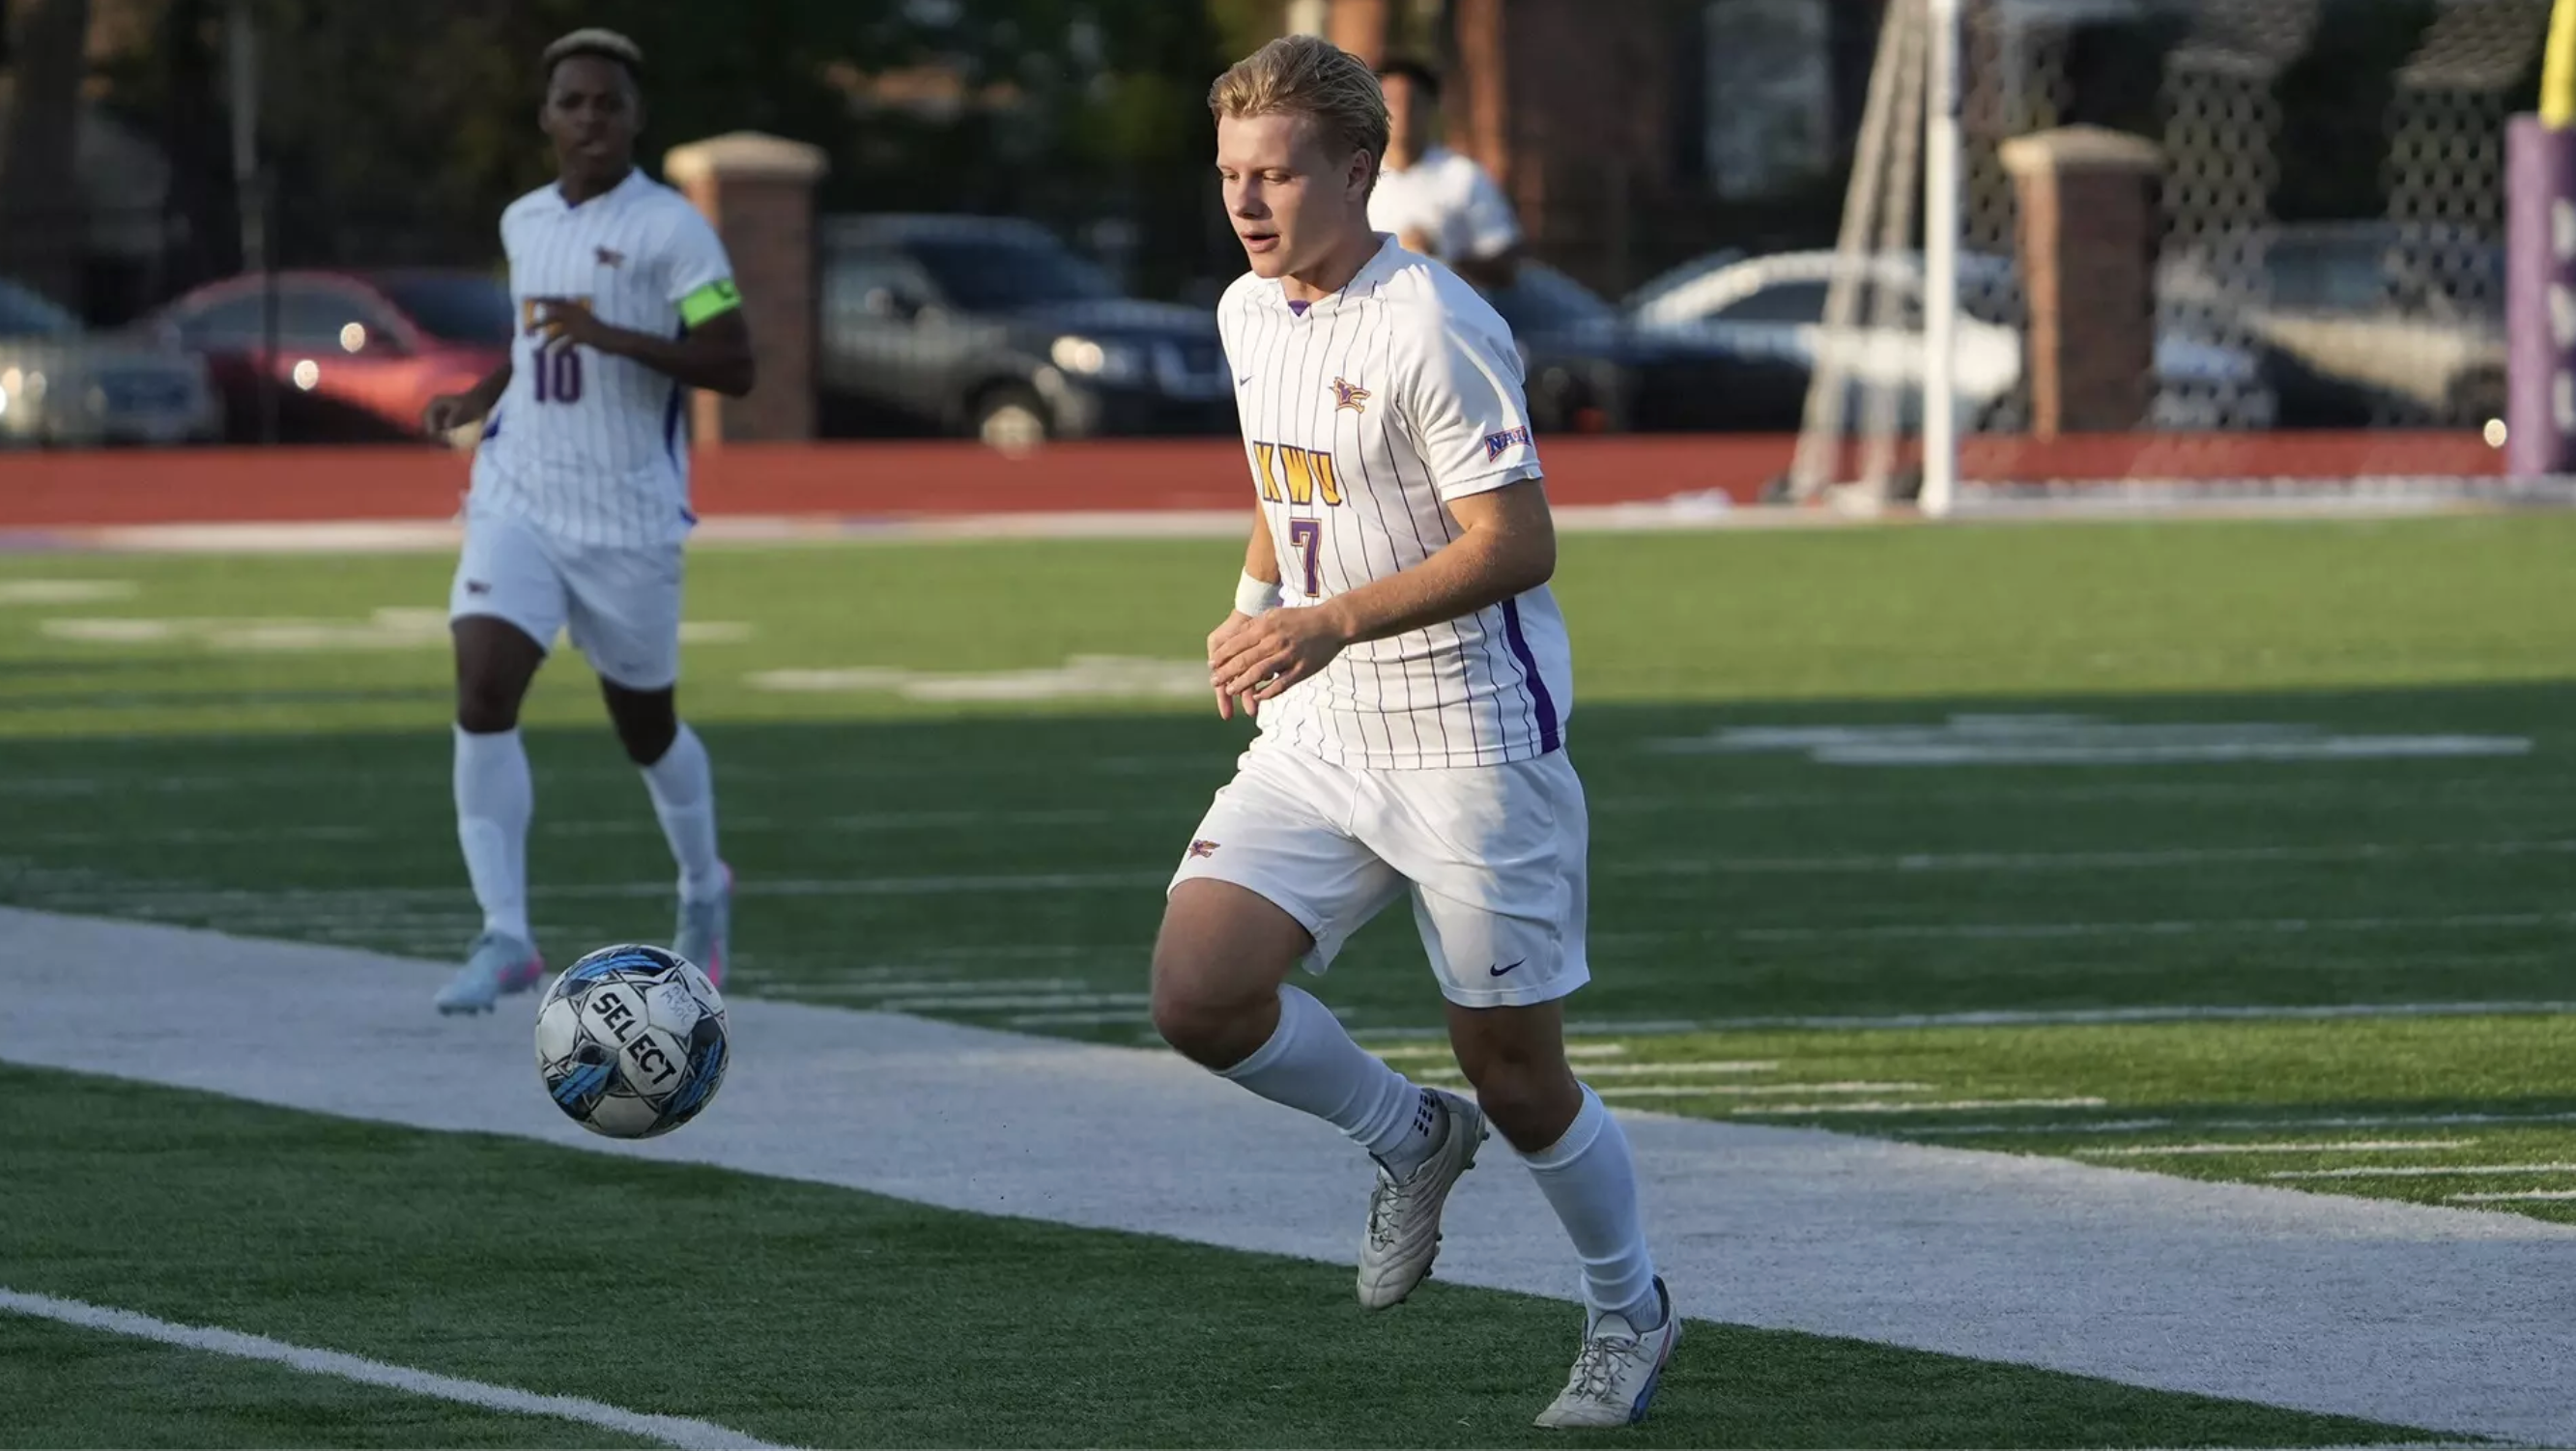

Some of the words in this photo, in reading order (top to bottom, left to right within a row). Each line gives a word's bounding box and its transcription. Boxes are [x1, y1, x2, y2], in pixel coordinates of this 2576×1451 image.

[533, 347, 581, 404] 10
[1253, 441, 1342, 506] KWU
[1290, 519, 1322, 598] 7
[592, 992, 676, 1085] SELECT
